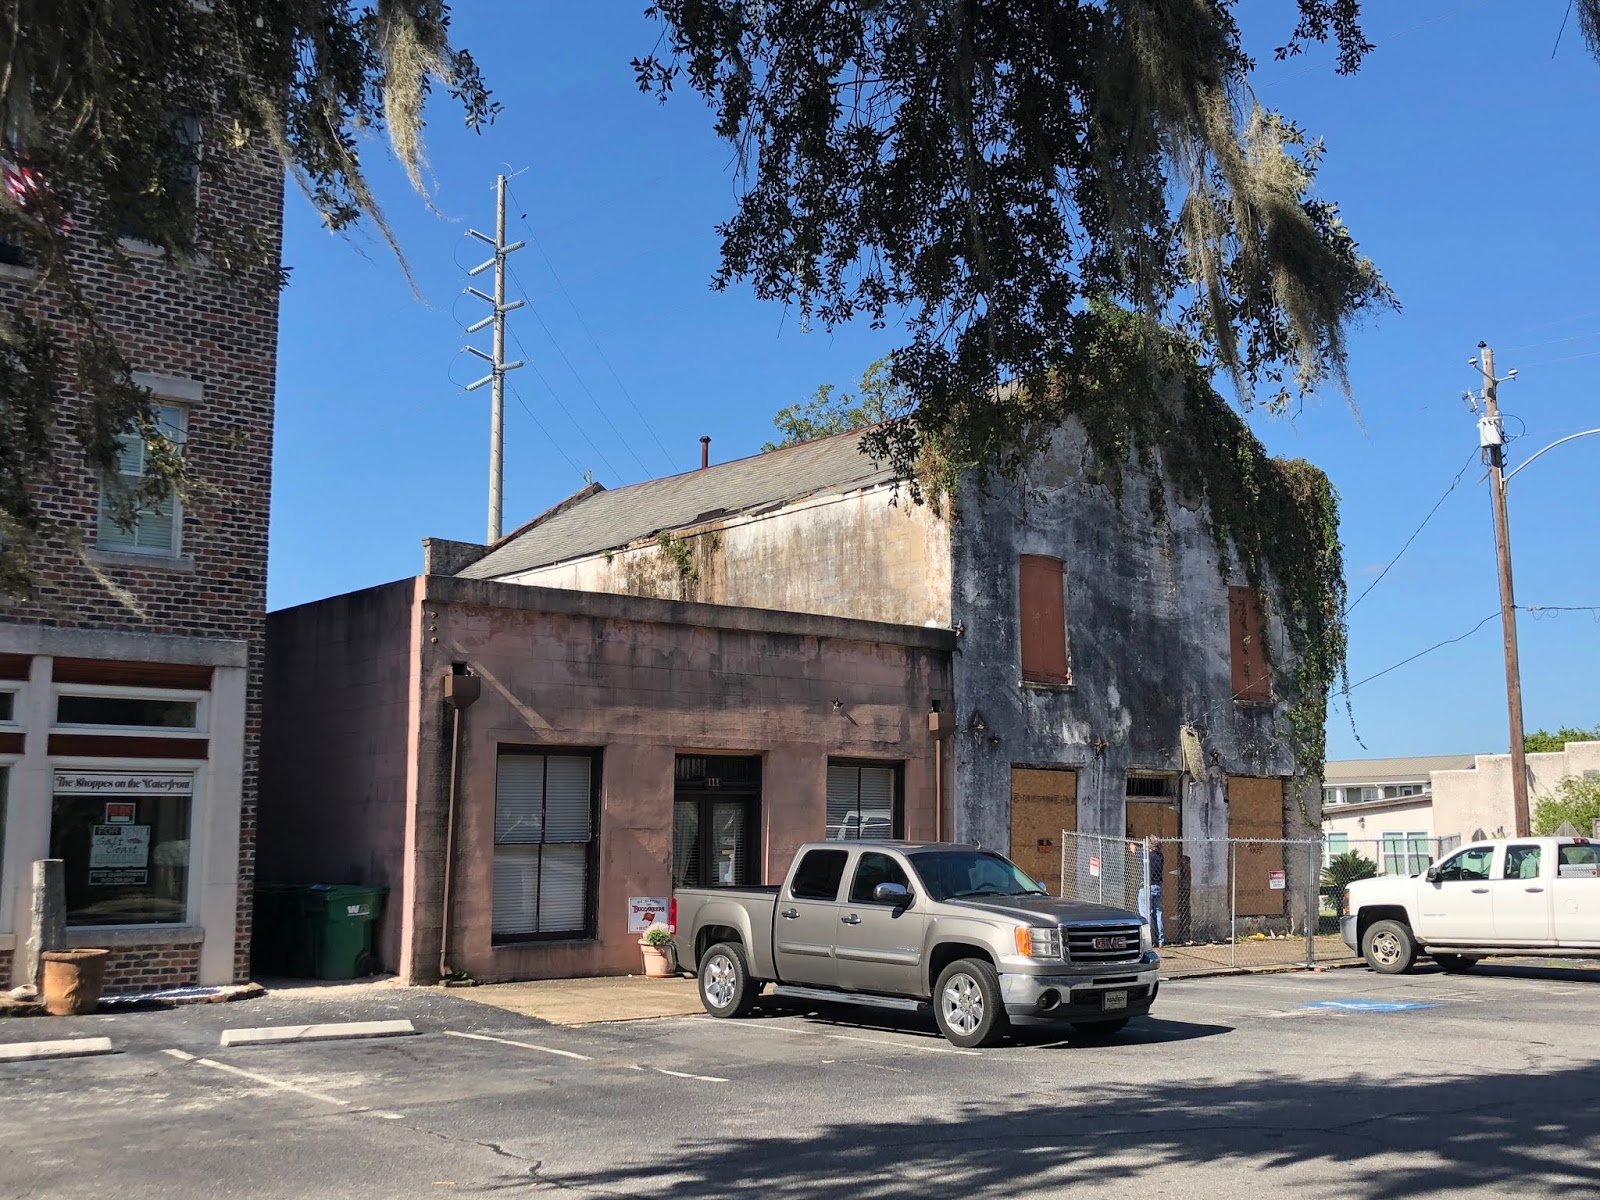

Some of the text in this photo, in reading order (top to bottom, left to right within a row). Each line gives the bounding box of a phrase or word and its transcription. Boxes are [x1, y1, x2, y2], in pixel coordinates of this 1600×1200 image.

[56, 776, 190, 790] The Shoppes on the Waterfront
[708, 777, 719, 787] 111
[1093, 936, 1127, 949] GMC
